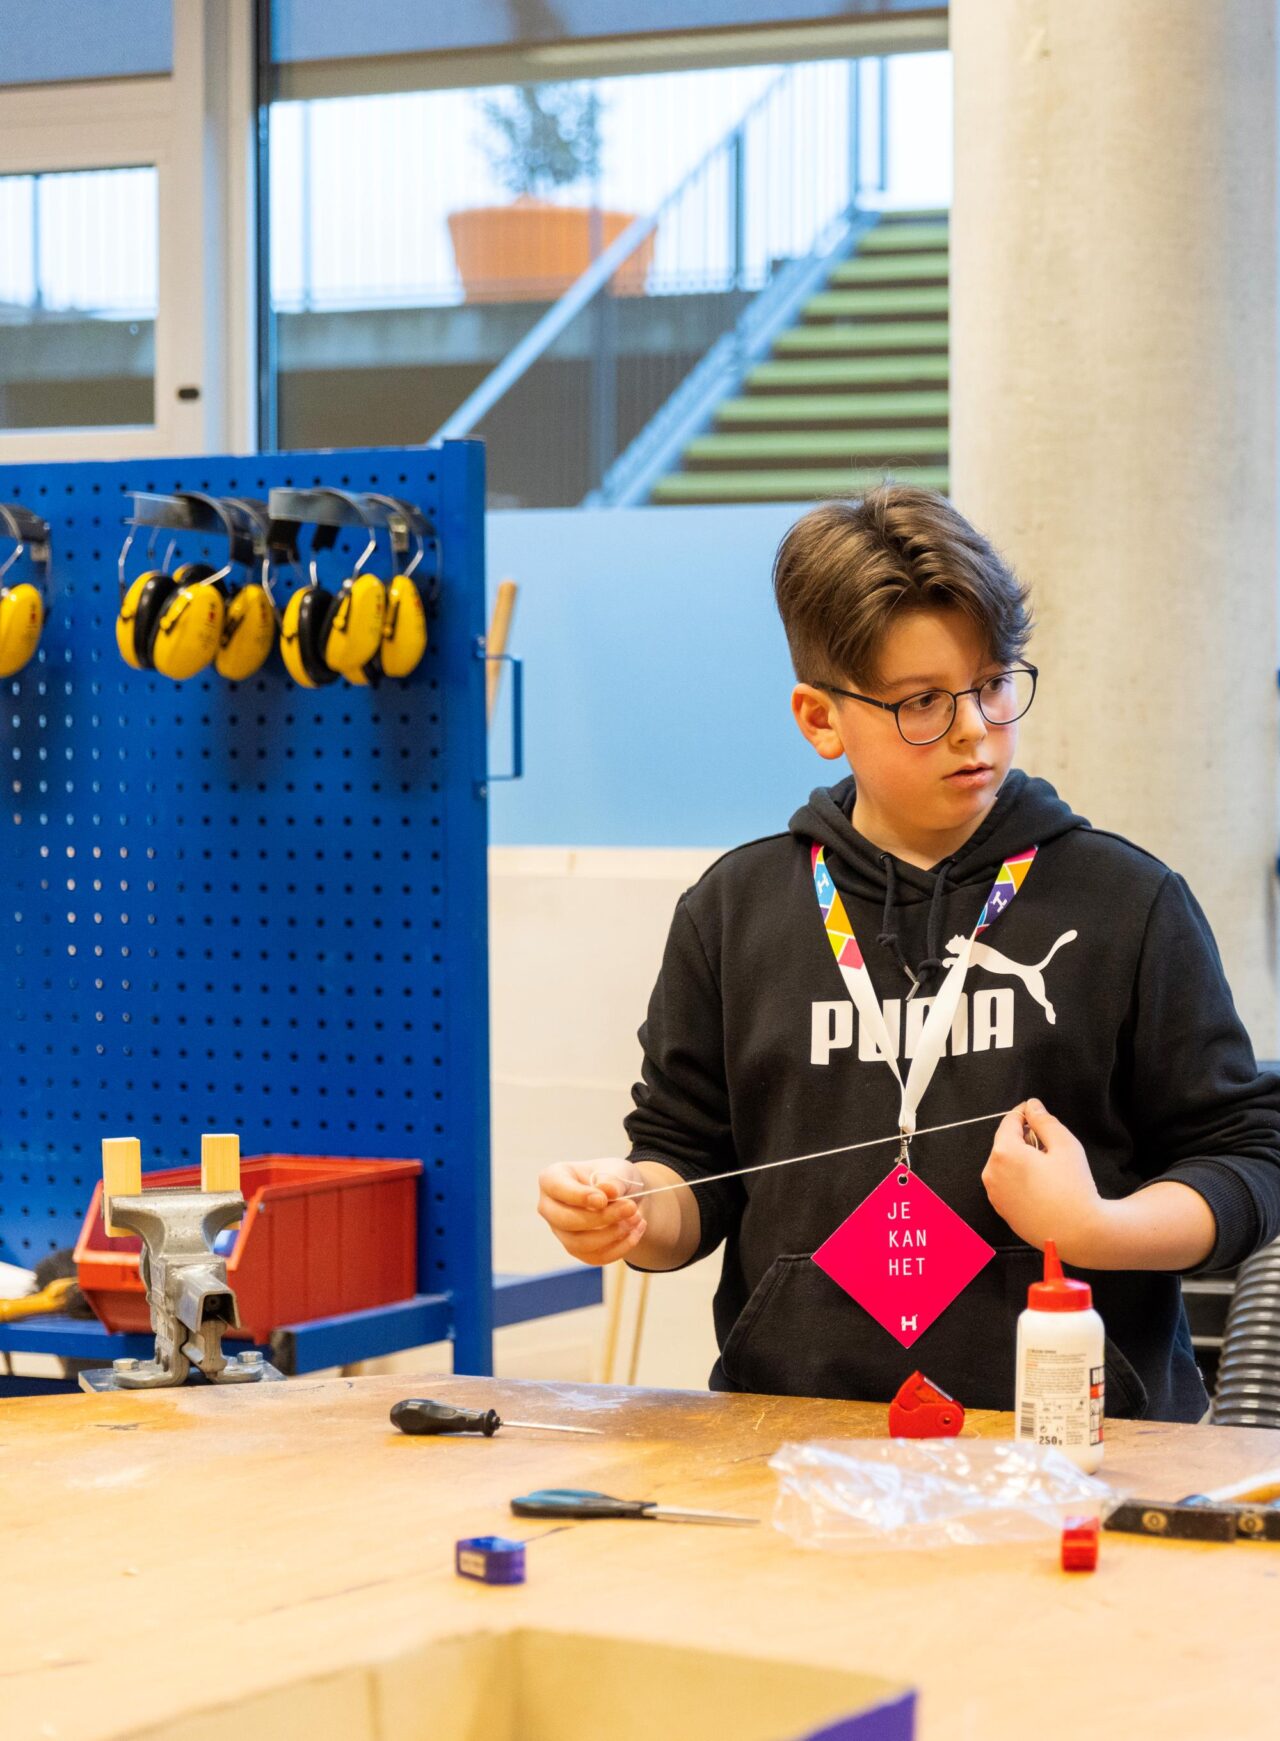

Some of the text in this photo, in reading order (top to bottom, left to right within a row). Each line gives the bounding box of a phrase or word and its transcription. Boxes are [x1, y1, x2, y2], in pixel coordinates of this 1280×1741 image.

[887, 1201, 911, 1220] JE
[888, 1229, 927, 1248] KAN
[888, 1257, 926, 1276] HET
[900, 1313, 918, 1332] H
